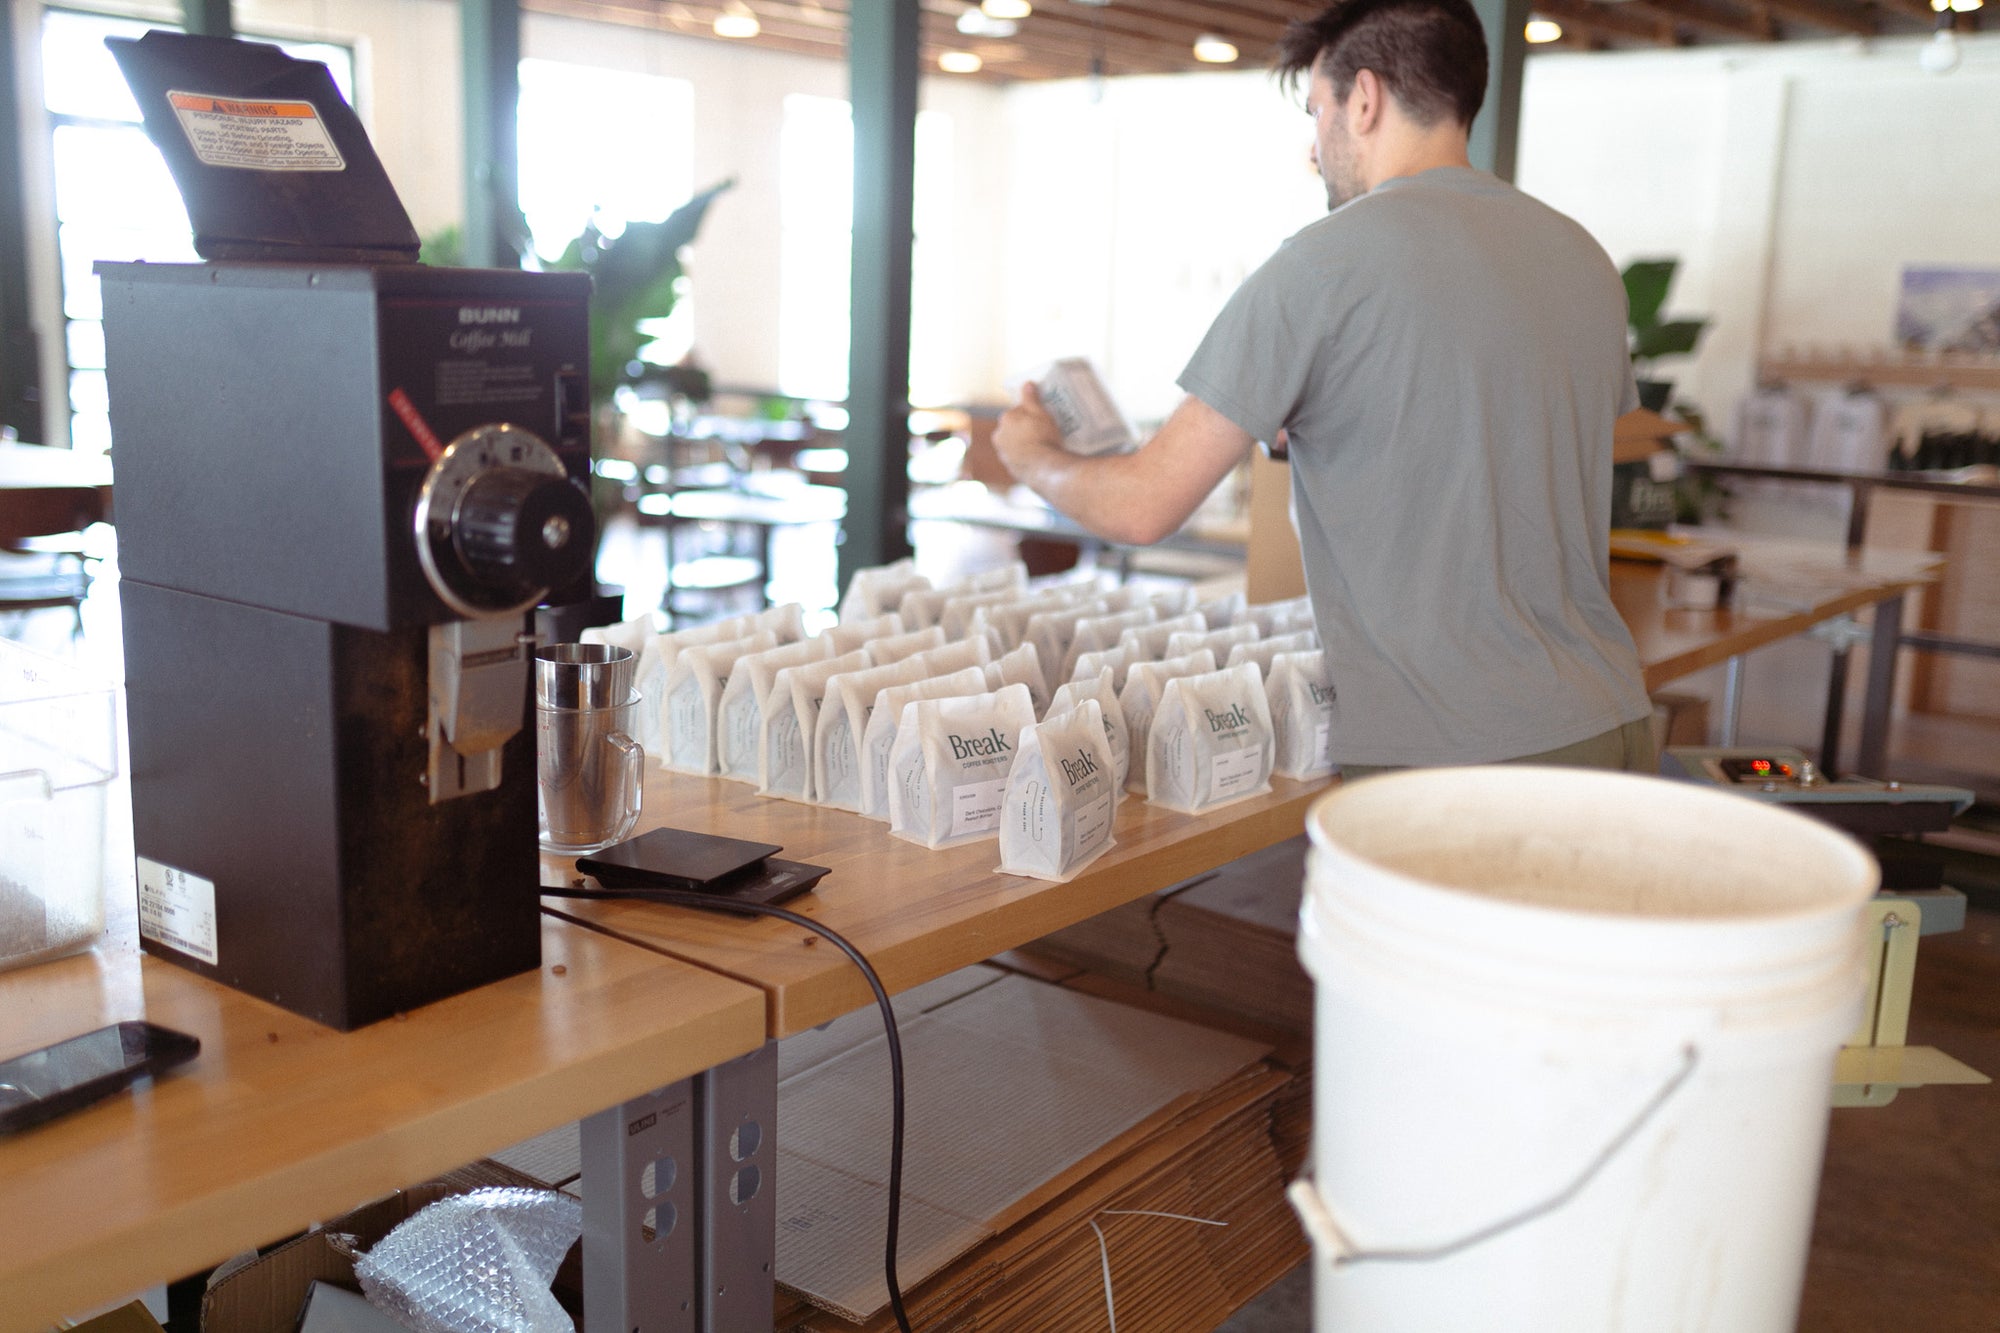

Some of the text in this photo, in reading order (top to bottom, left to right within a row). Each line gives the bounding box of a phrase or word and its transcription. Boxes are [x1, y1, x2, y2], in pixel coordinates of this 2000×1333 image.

[193, 112, 303, 126] PERSONAL INJURY HAZARD
[227, 103, 278, 115] WARNING
[459, 307, 520, 324] BUNN
[1204, 703, 1251, 732] Break
[948, 728, 1011, 760] Break
[1060, 748, 1098, 786] Break
